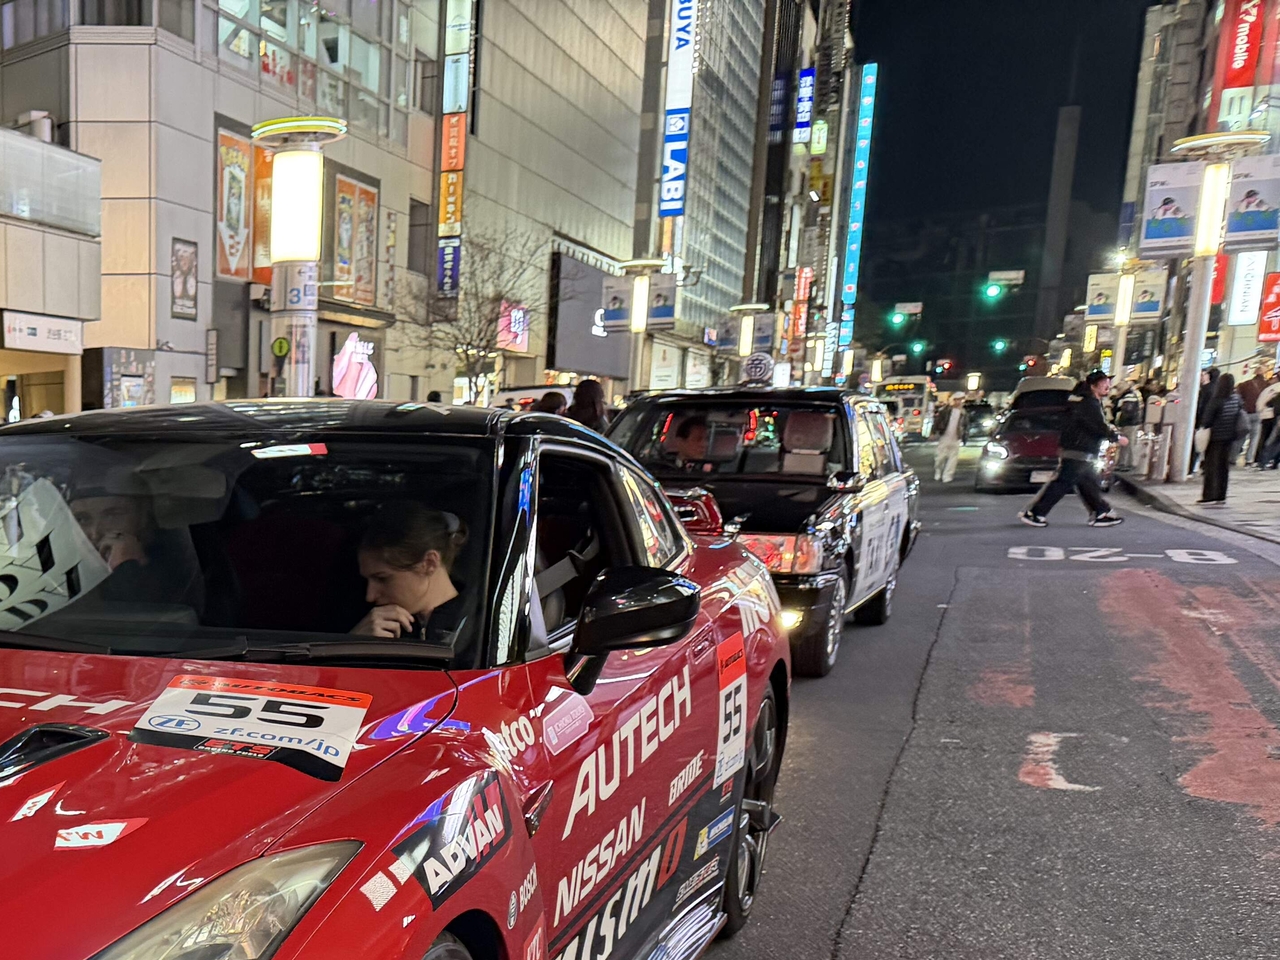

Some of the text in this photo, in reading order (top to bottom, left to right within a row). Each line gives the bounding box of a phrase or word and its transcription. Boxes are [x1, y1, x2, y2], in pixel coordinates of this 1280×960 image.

[676, 0, 693, 50] UYA
[659, 140, 688, 210] LABI
[154, 716, 341, 759] ZF zf.com/jp
[184, 692, 331, 729] 55
[723, 682, 743, 745] 55
[562, 664, 691, 841] AUTECH
[668, 749, 704, 807] BRIDE
[422, 803, 504, 895] ADVAN
[553, 797, 646, 928] NISSAN
[519, 862, 538, 913] BOSCH
